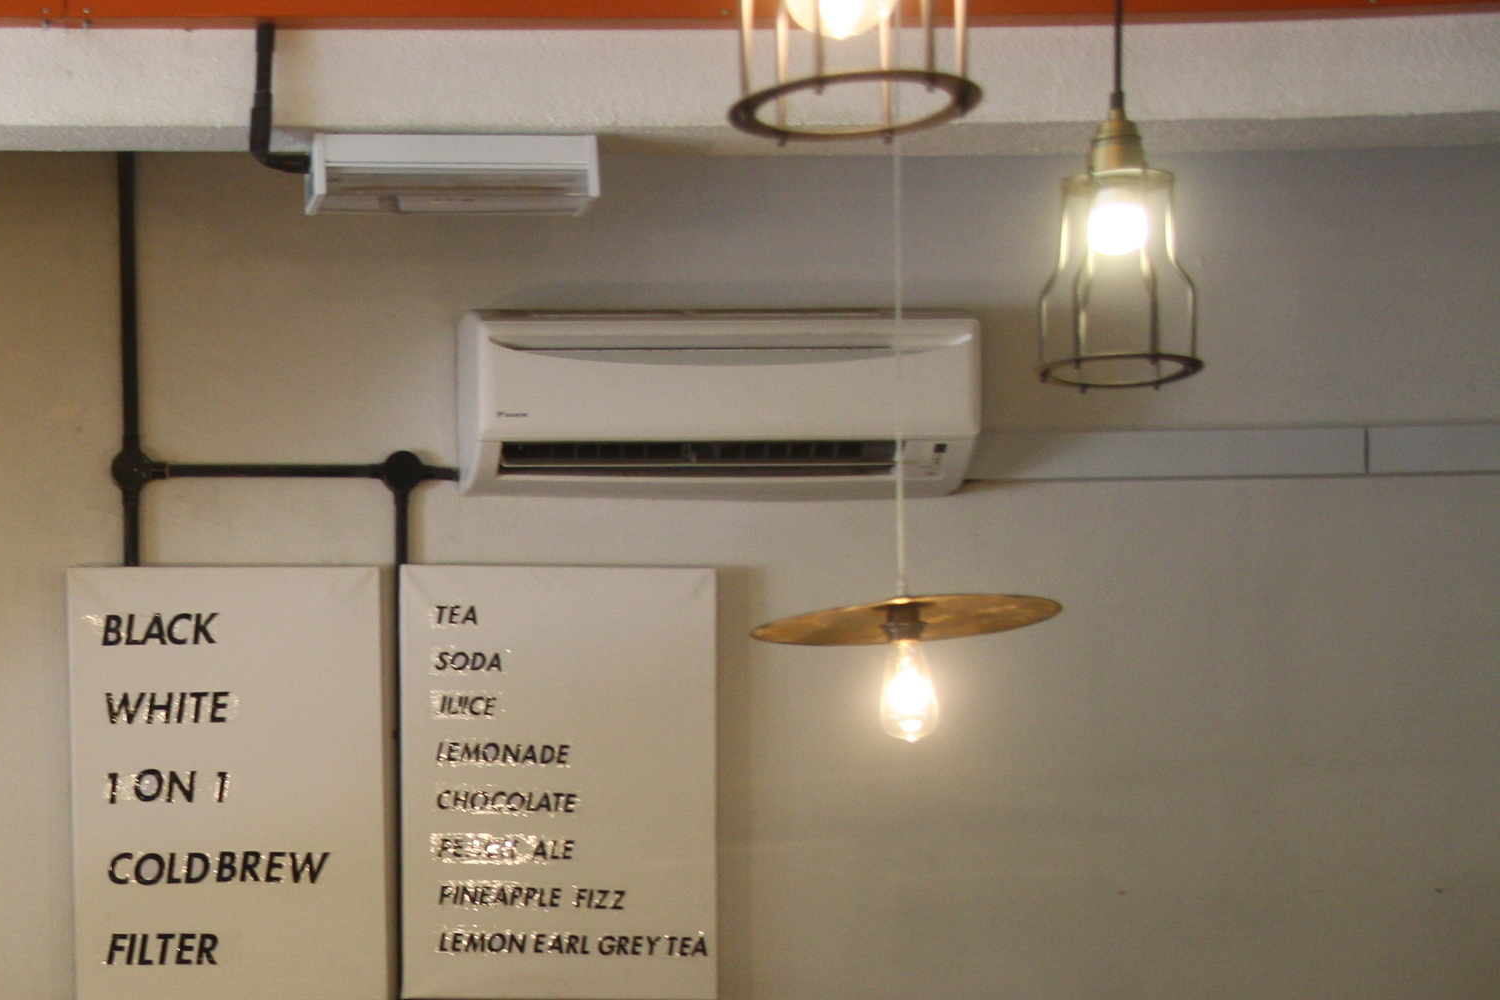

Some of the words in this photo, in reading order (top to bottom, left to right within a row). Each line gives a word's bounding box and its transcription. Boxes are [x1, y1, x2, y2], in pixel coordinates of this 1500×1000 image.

[435, 605, 478, 625] TEA
[102, 613, 219, 646] BLACK
[435, 651, 503, 672] SODA
[105, 691, 231, 724] WHITE
[436, 742, 570, 764] LEMONADE
[107, 772, 119, 804] 1
[134, 769, 197, 803] ON
[216, 771, 229, 803] 1
[437, 789, 577, 813] CHOCOLATE
[532, 840, 575, 861] ALE
[439, 885, 562, 908] PINEAPPLE
[575, 888, 627, 910] FIZZ
[106, 933, 219, 966] FILTER
[439, 932, 528, 954] LEMON
[533, 934, 590, 955] EARL
[598, 935, 661, 956] GREY
[666, 936, 709, 957] TEA
